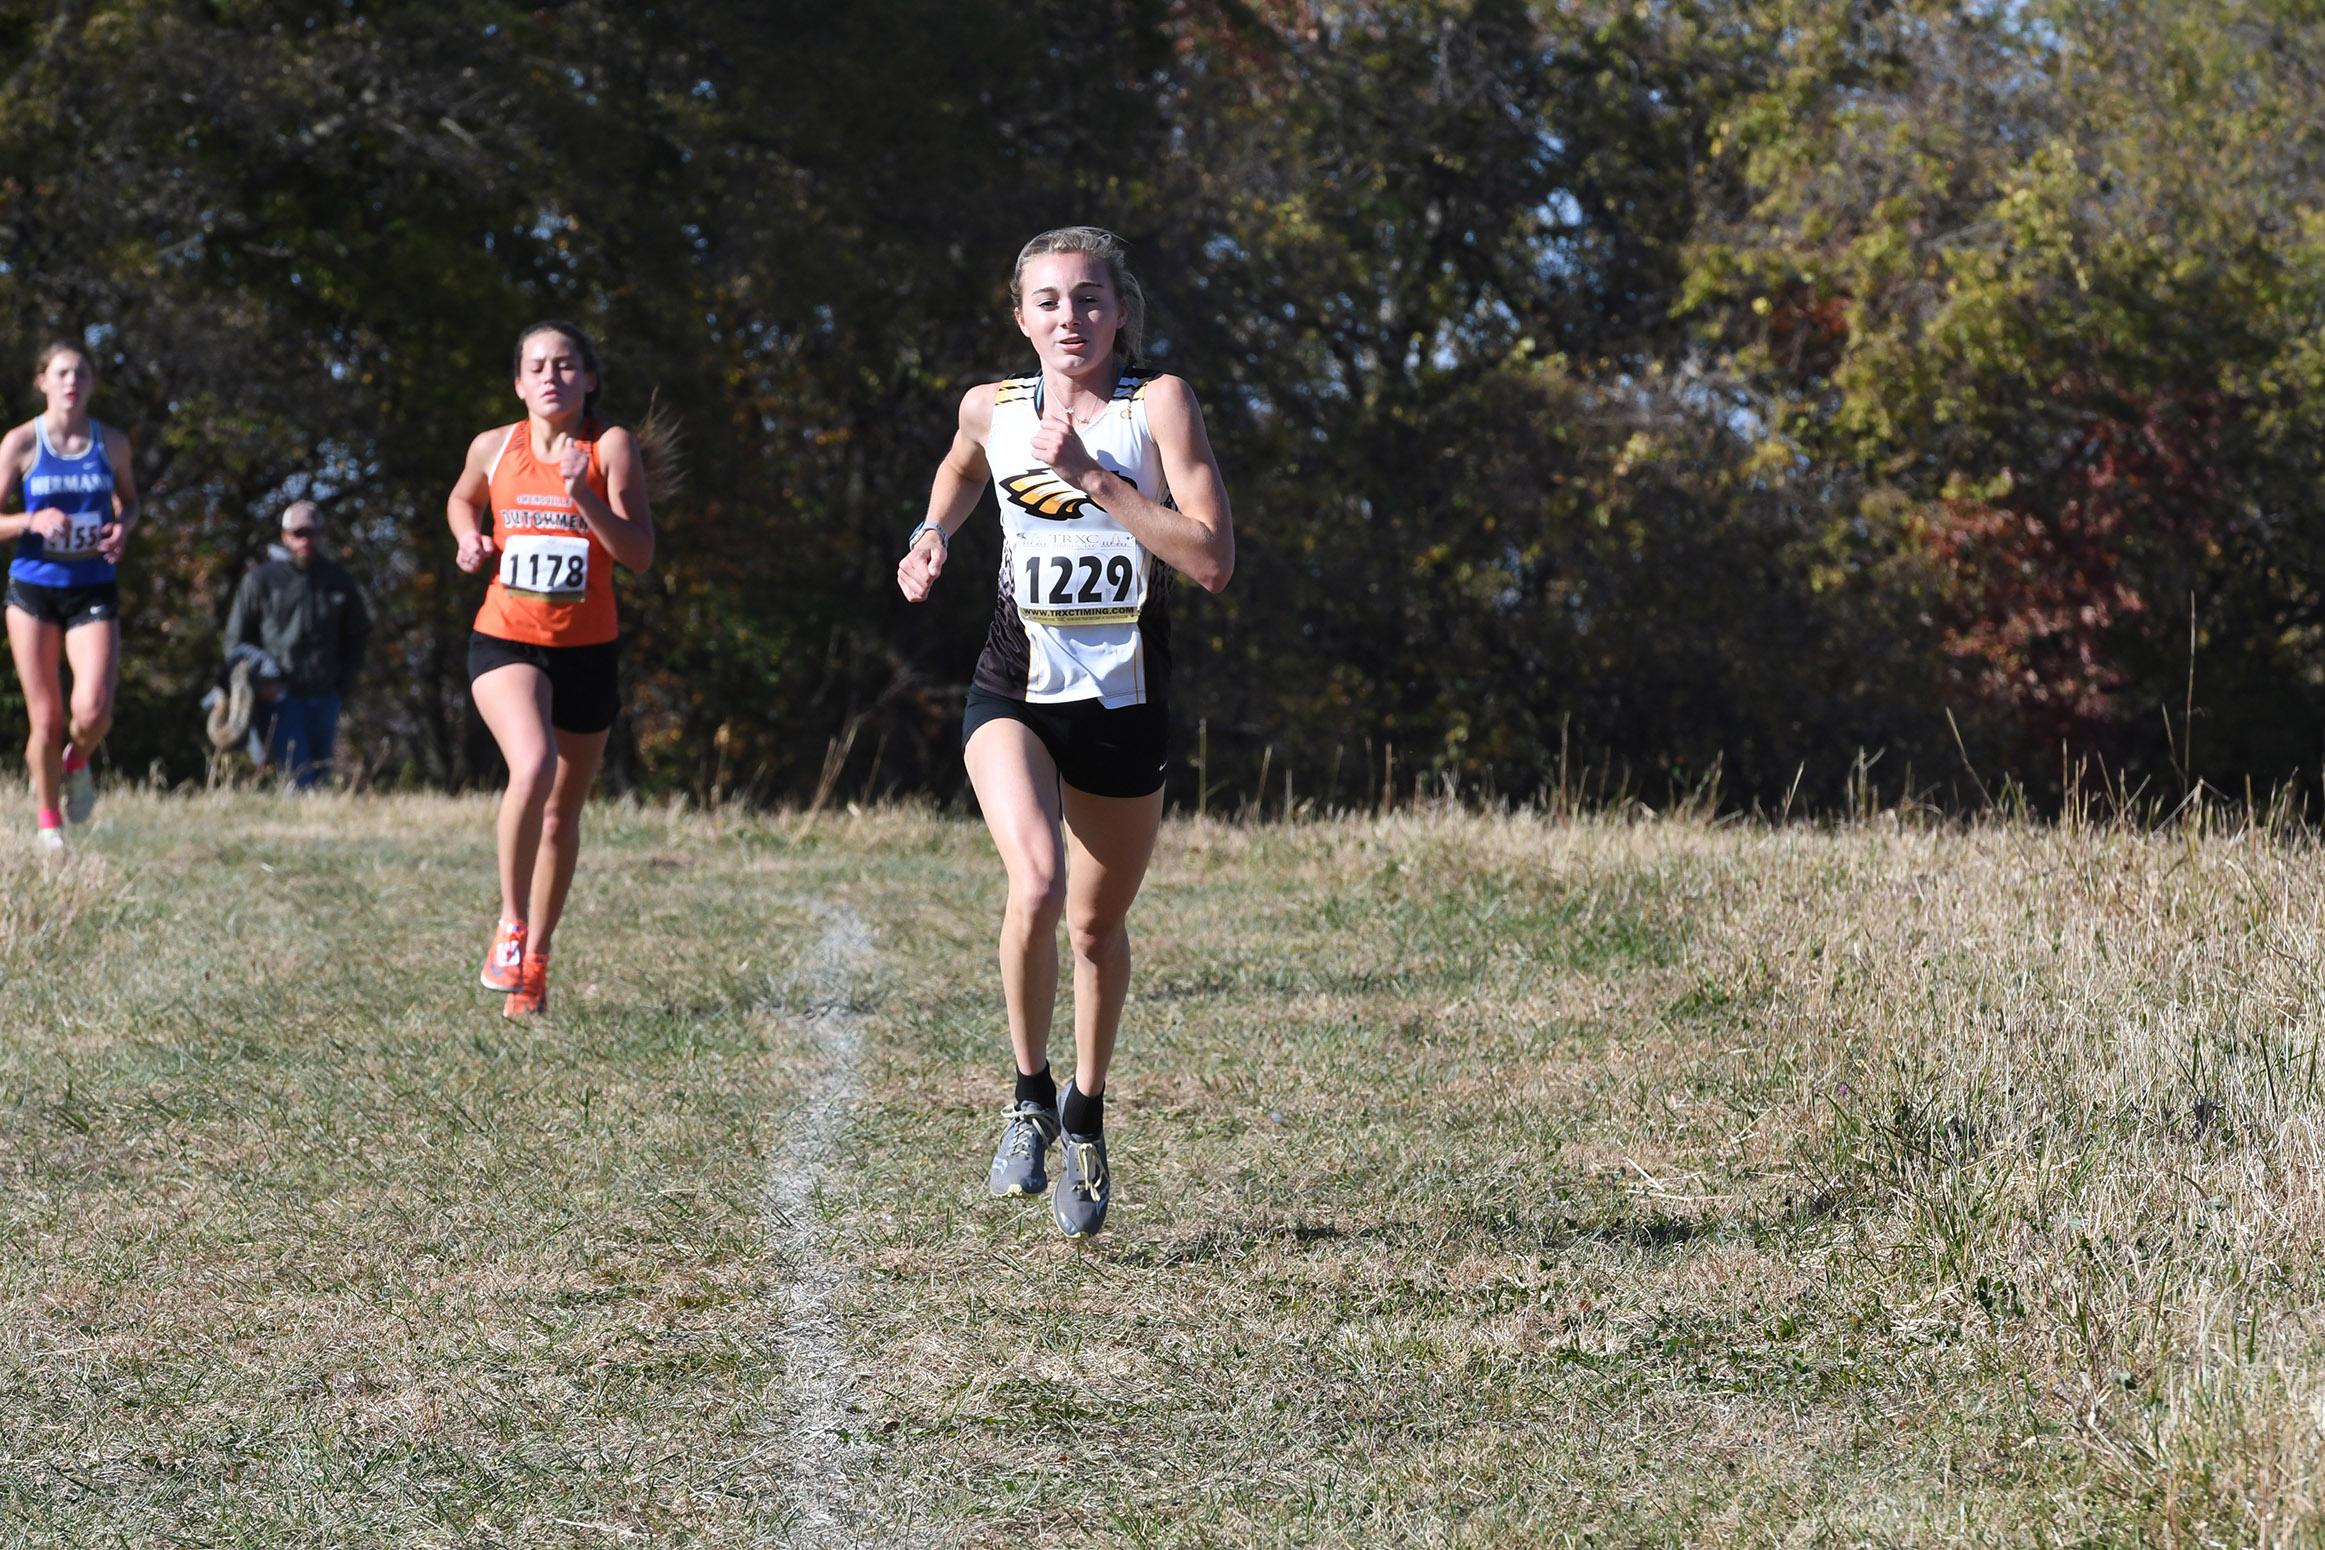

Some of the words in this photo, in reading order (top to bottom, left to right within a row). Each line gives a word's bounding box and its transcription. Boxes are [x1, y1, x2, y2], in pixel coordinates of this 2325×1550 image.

[1049, 534, 1100, 544] TRXC
[510, 553, 584, 588] 1178
[1025, 555, 1133, 604] 1229
[1023, 606, 1135, 617] WWW.TRXCTIMING.COM
